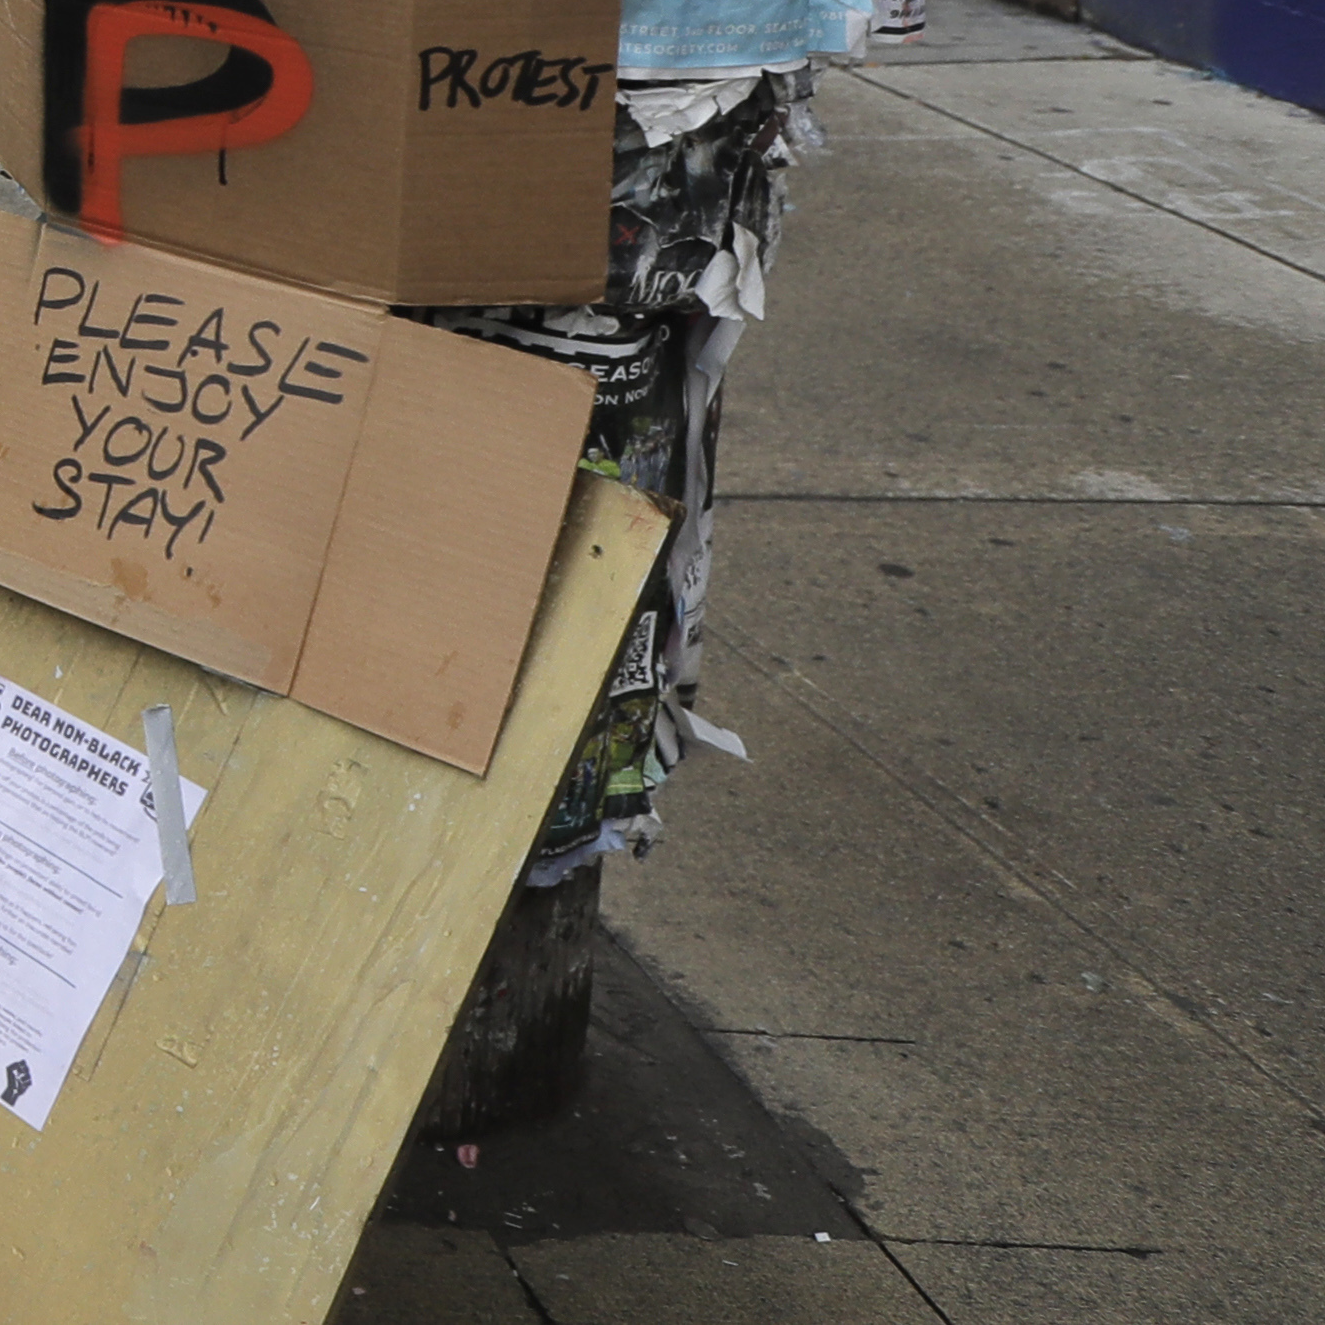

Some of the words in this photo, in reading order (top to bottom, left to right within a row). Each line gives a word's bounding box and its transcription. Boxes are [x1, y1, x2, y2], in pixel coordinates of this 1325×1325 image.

[418, 46, 616, 111] PROTEST
[33, 267, 369, 404] PLEASE
[37, 338, 284, 441] ENJOY
[71, 394, 227, 503] YOUR
[32, 459, 217, 577] STAY!
[0, 715, 130, 798] PHOTOGRAPHERS
[10, 695, 53, 726] DEAR
[51, 716, 143, 777] NON-BLACK
